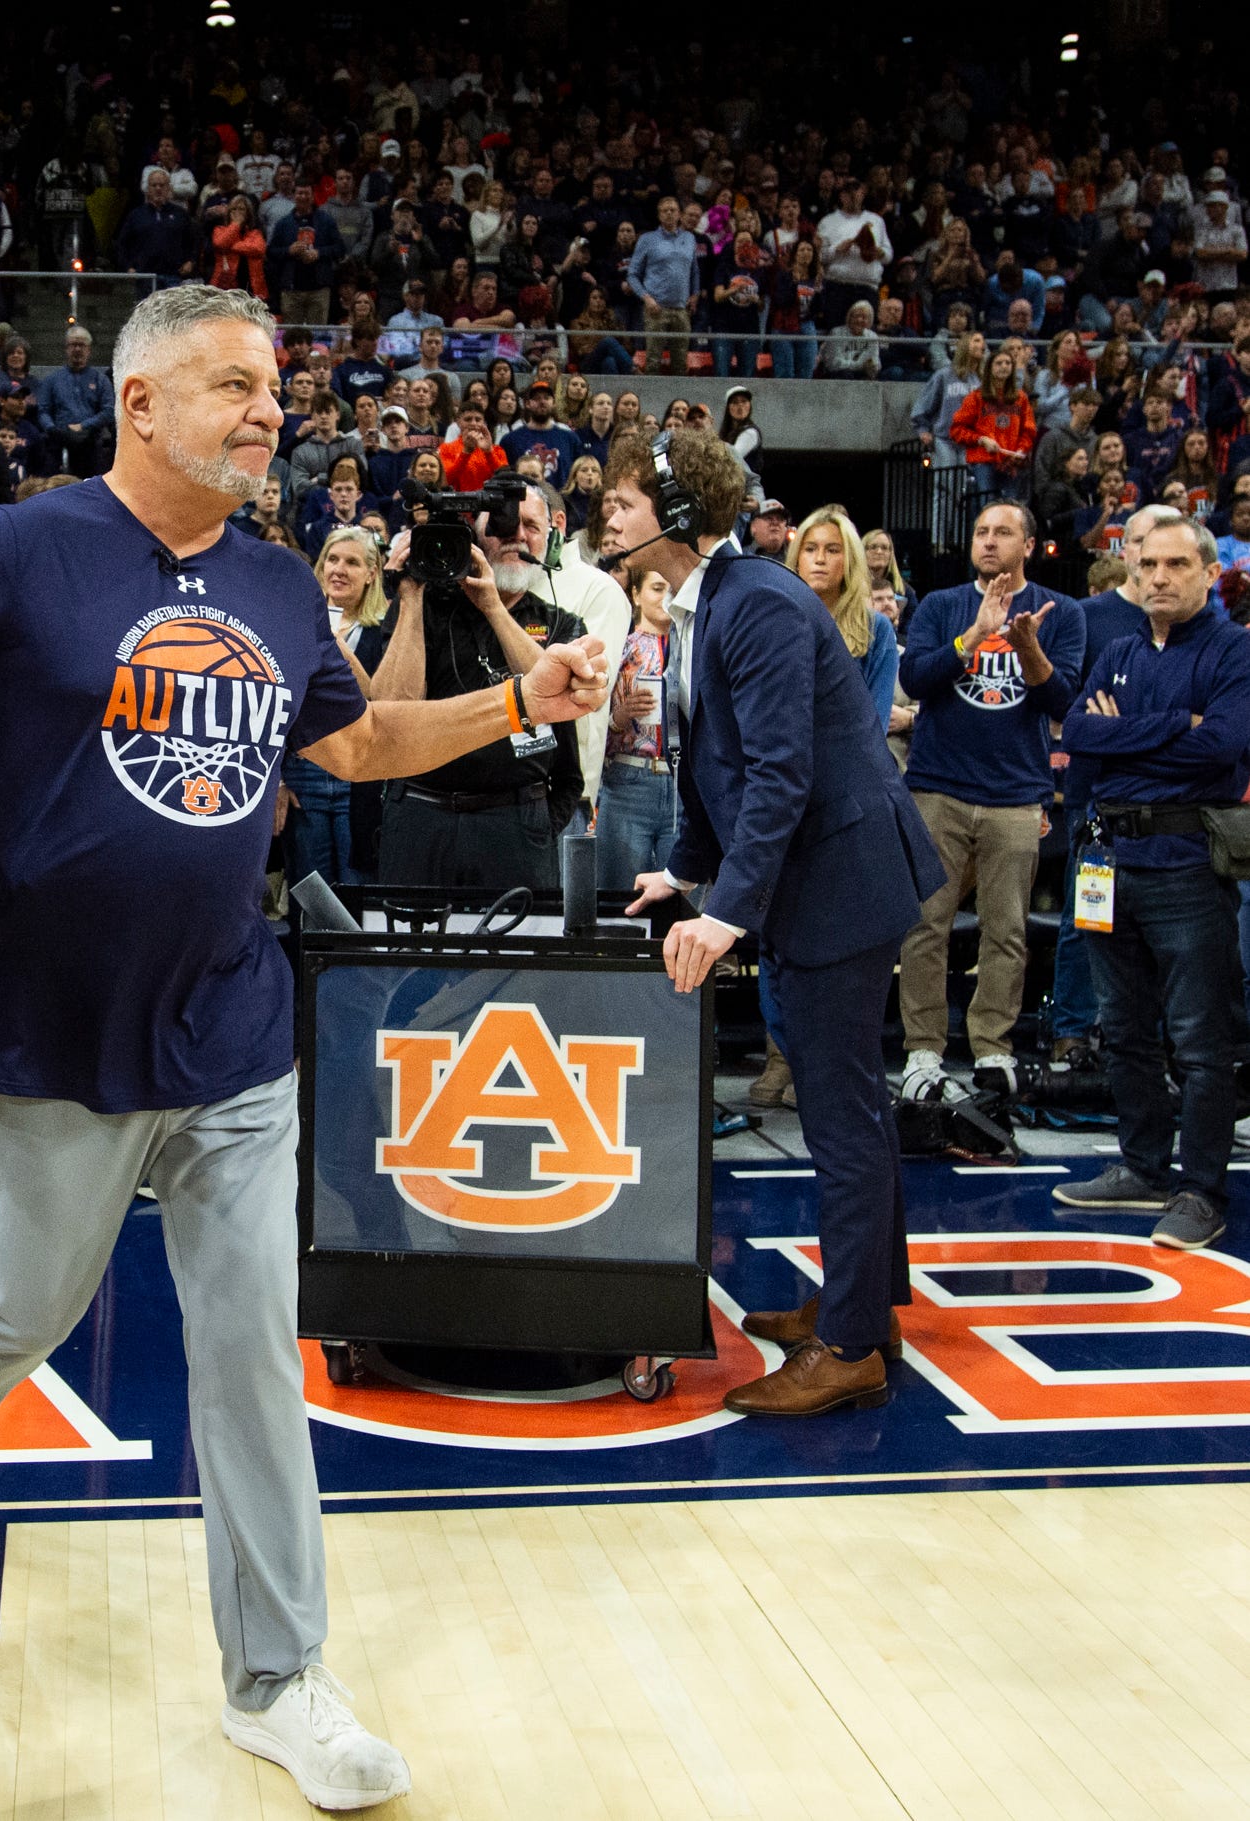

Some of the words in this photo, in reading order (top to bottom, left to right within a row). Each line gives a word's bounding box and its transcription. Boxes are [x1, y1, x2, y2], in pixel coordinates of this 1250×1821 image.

[115, 626, 144, 664] AUBURN
[137, 604, 199, 634] BASKETBALL'S
[199, 605, 227, 623] FIGHT
[226, 615, 264, 648] AGAINST
[260, 645, 286, 684] CANCER
[101, 665, 293, 748] AUTLIVE
[1081, 866, 1112, 879] AHSAA
